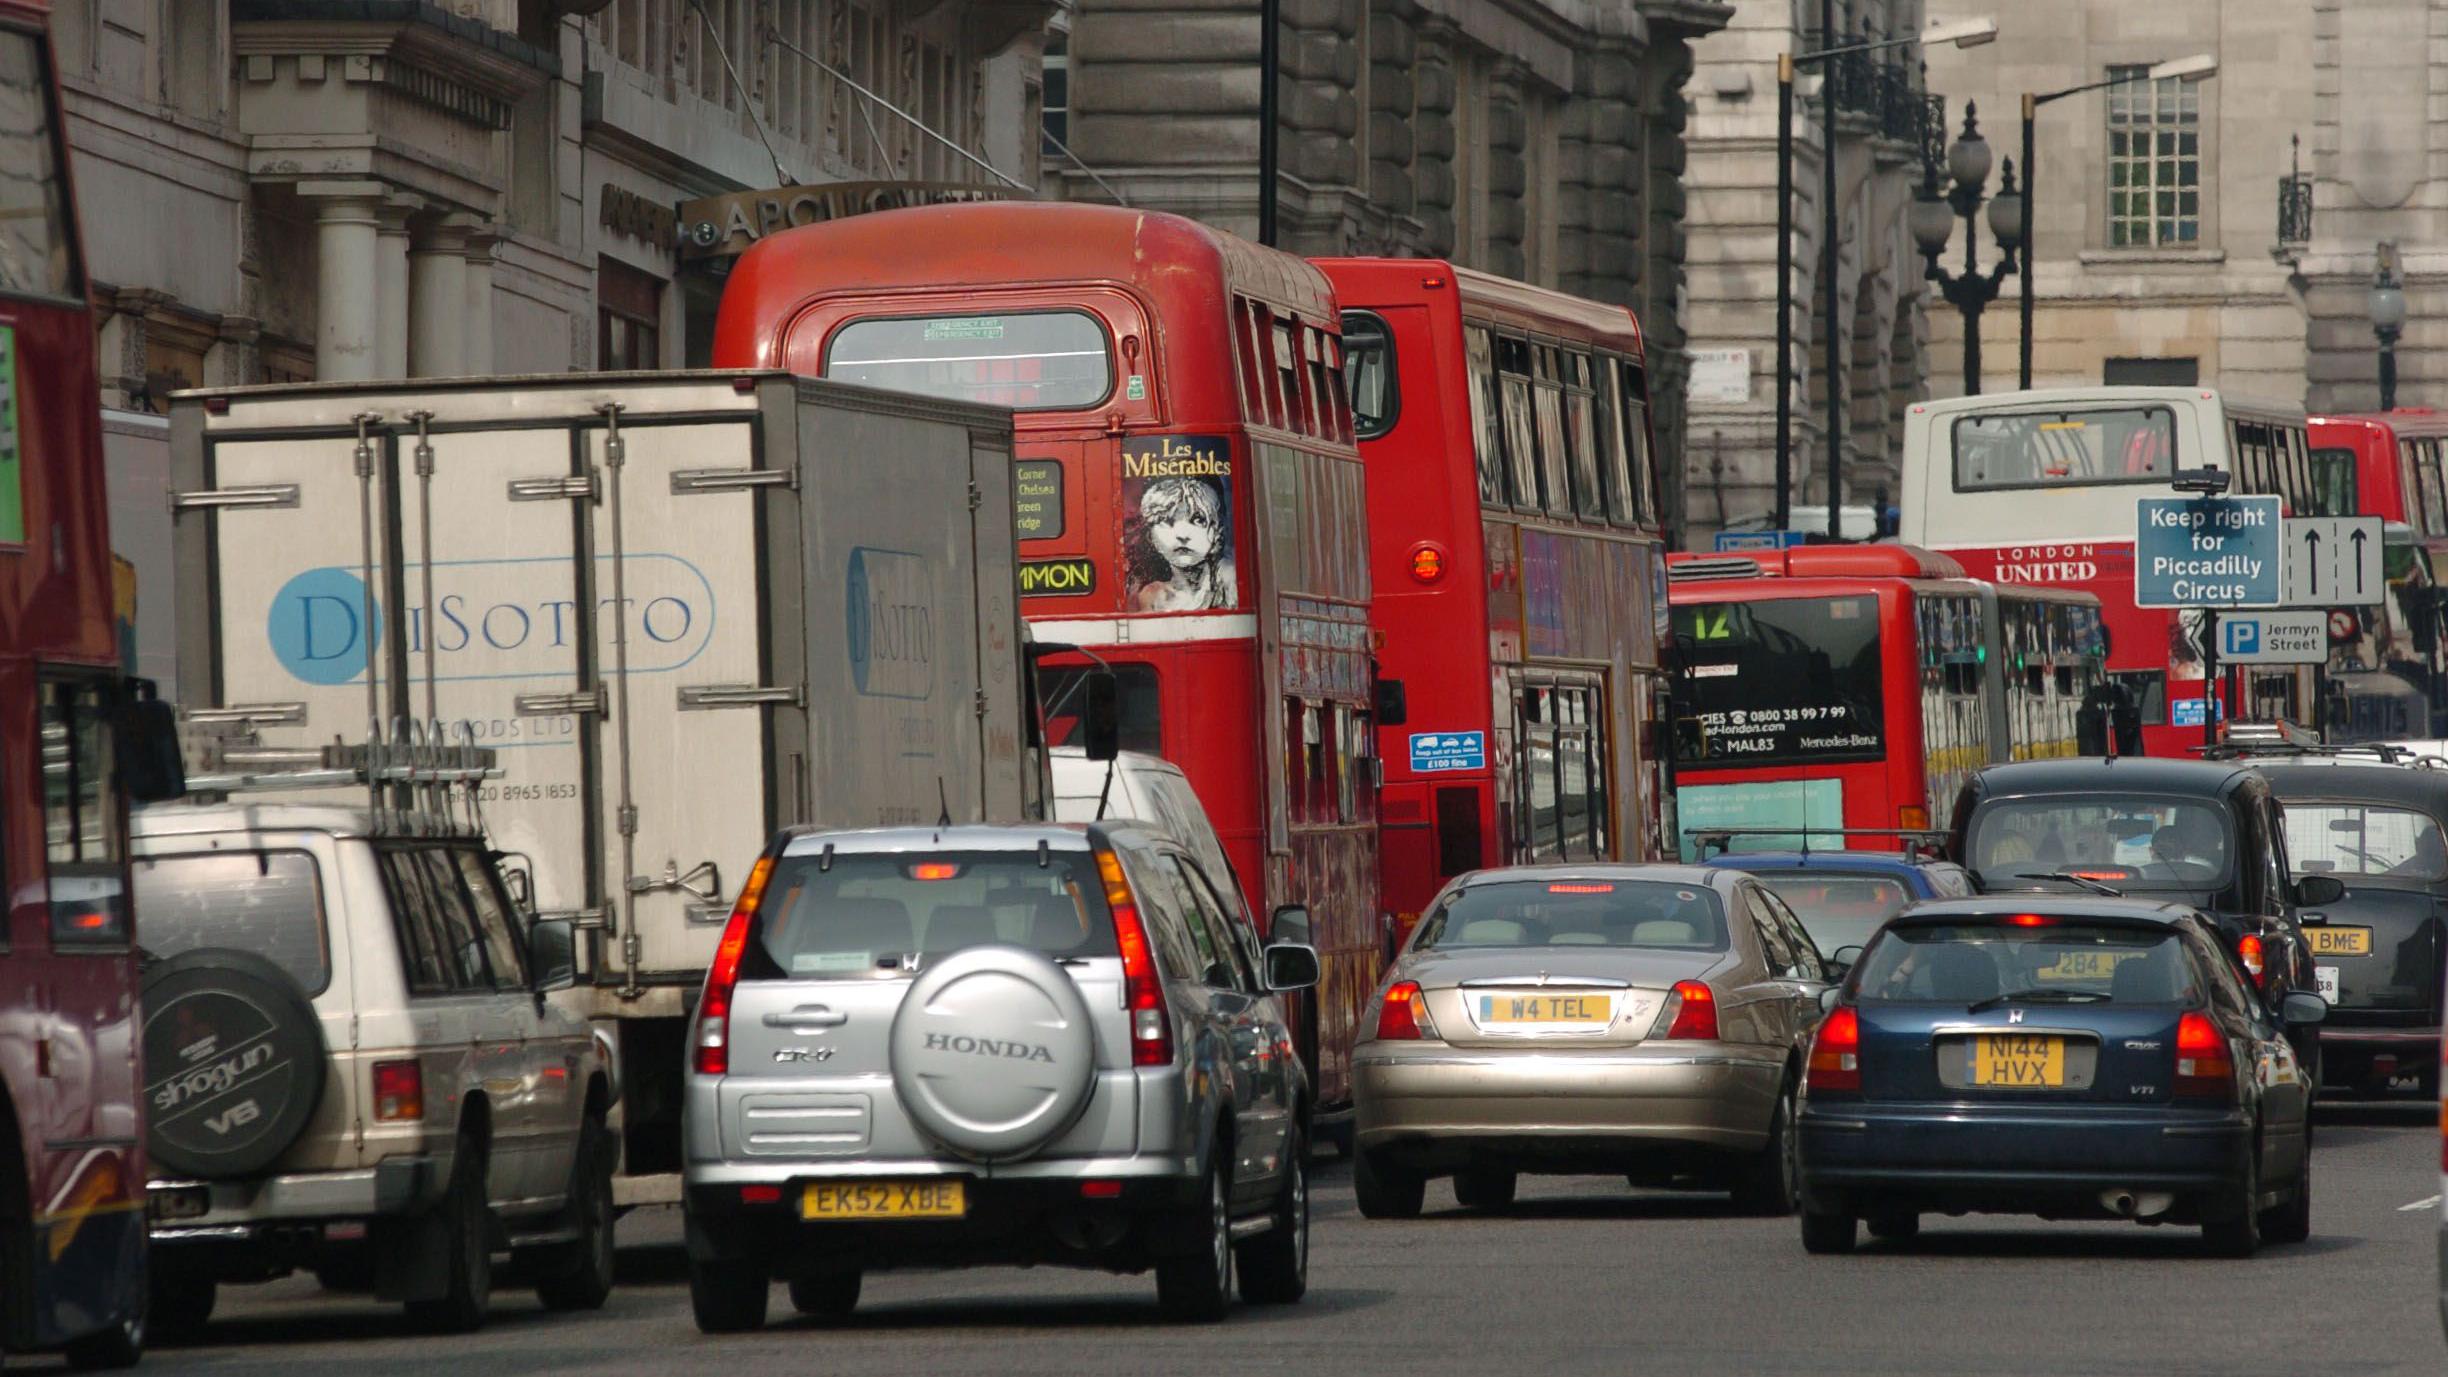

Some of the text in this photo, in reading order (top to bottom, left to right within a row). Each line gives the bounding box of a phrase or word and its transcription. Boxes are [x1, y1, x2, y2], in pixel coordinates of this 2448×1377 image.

[1163, 439, 1192, 458] Les
[1018, 468, 1046, 480] Corner
[1123, 450, 1231, 478] Misérables
[1019, 484, 1055, 496] Chelsea
[1017, 517, 1041, 531] ridge
[2151, 507, 2266, 529] Keep right
[2192, 532, 2224, 551] for
[1996, 544, 2093, 560] LONDON
[1995, 561, 2097, 583] UNITED
[2154, 556, 2262, 578] Piccadilly
[2173, 580, 2246, 600] Circus
[1694, 604, 1730, 640] 12
[2267, 624, 2320, 638] Jermyn
[2233, 624, 2255, 652] P
[2270, 639, 2317, 650] Street
[533, 716, 573, 736] LTD
[1697, 706, 1846, 726] CIES 0800 38 99 7 99
[1705, 721, 1786, 736] ad-london.com
[1727, 738, 1775, 753] MAL83
[1800, 734, 1878, 750] Mercedes-Benz
[503, 784, 541, 801] 8965
[545, 783, 577, 799] 1853
[2321, 933, 2361, 950] BME
[2053, 954, 2097, 974] 284
[1511, 998, 1592, 1019] W4 TEL
[922, 1032, 1056, 1064] HONDA
[1989, 1036, 2049, 1058] N144
[1992, 1060, 2048, 1083] HVX
[816, 1182, 953, 1213] EK52 XBE
